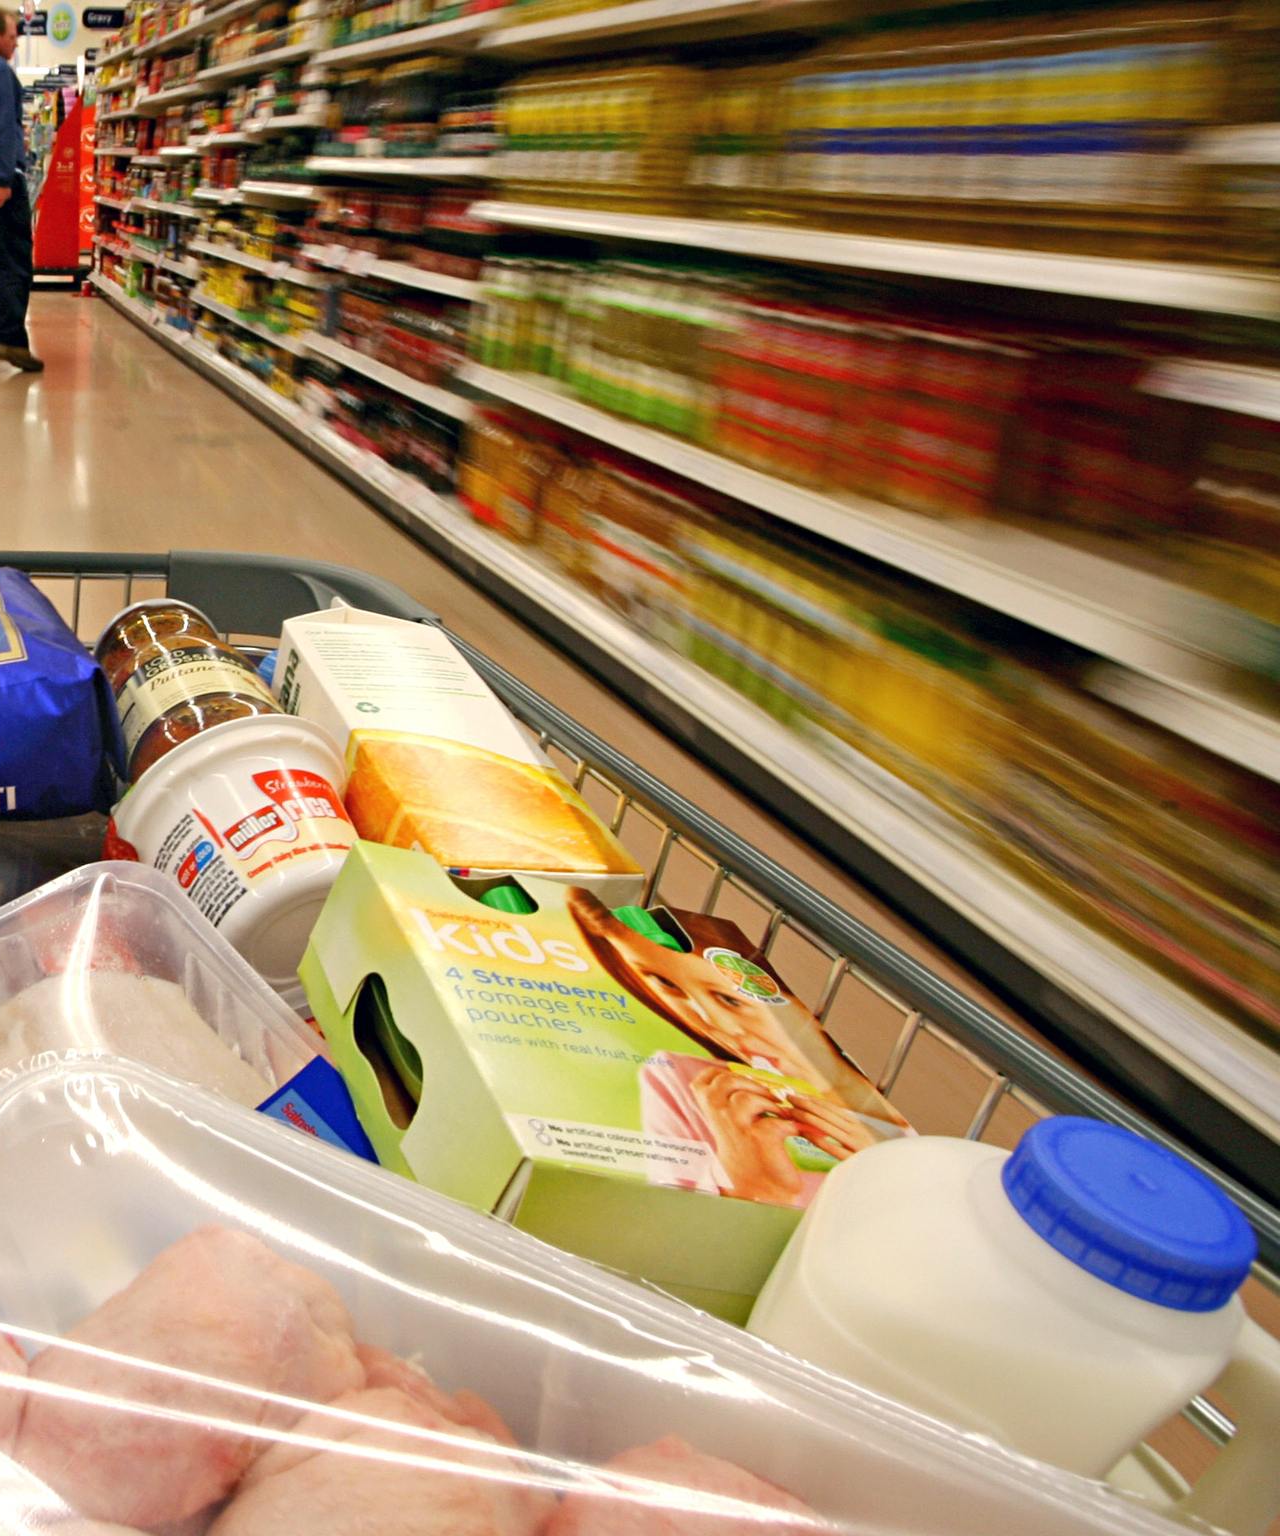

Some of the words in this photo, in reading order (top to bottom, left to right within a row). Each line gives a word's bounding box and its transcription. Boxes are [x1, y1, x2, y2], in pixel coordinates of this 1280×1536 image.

[410, 907, 590, 973] kids
[445, 967, 465, 981] 4
[472, 968, 628, 1009] Strawberry
[453, 985, 570, 1015] fromage
[576, 1002, 638, 1026] frais
[465, 1007, 584, 1035] pouches
[479, 1032, 521, 1046] made
[526, 1037, 561, 1052] with
[562, 1042, 593, 1056] real
[594, 1046, 628, 1060] fruit
